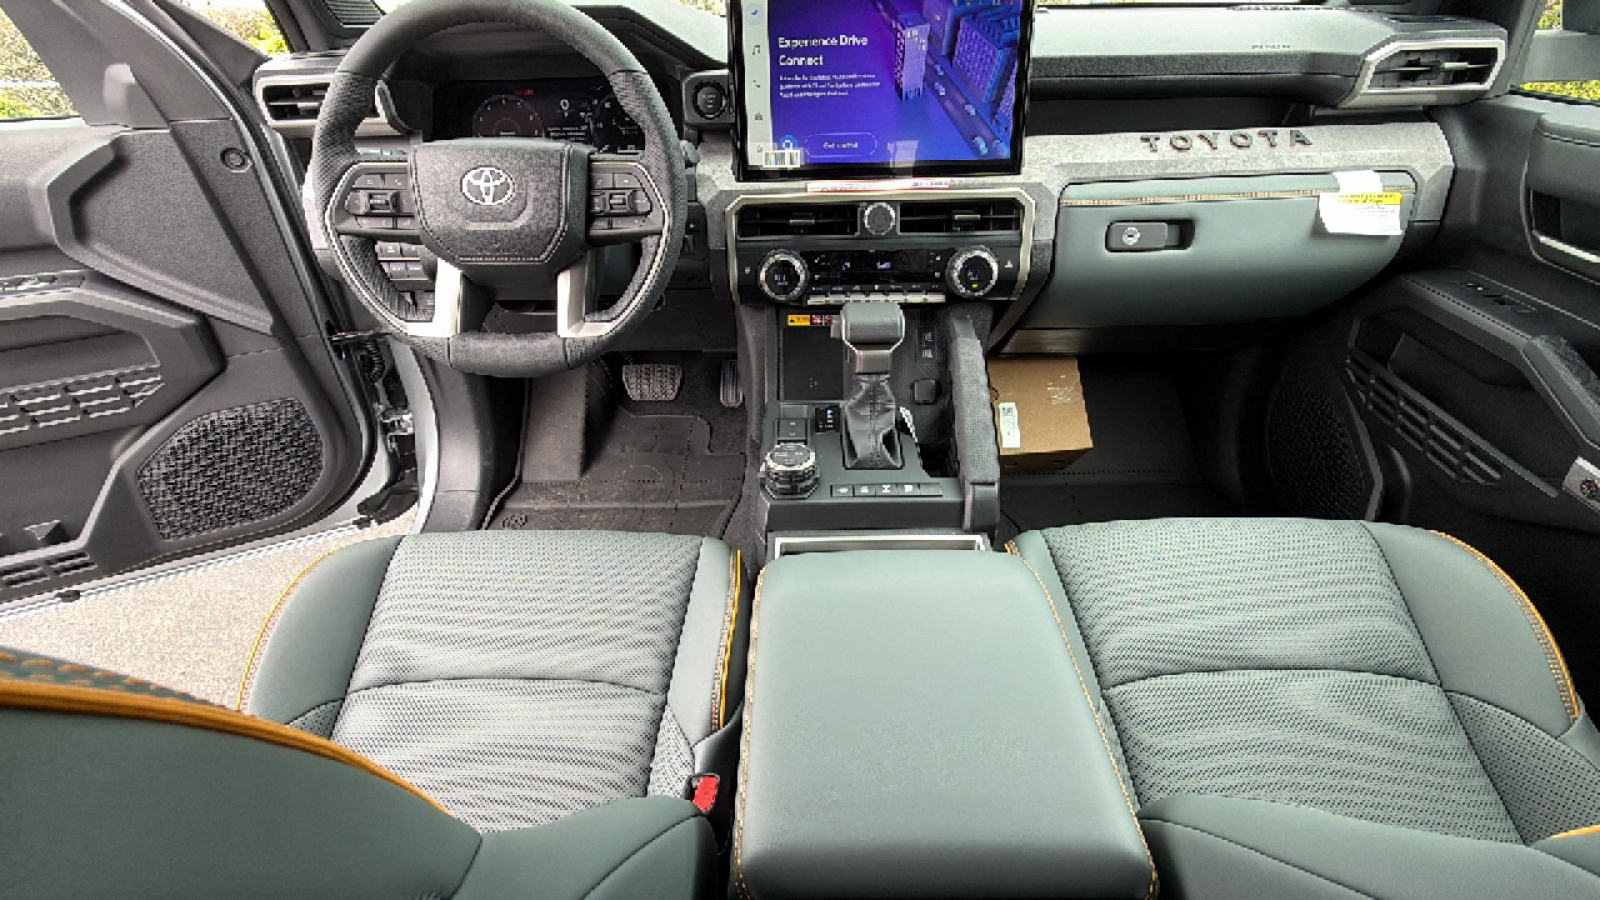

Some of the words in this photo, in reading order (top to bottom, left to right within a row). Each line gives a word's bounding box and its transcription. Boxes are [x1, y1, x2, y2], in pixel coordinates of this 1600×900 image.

[778, 37, 838, 50] Experience
[839, 35, 868, 46] Drive
[779, 55, 824, 66] Connect
[1140, 129, 1313, 153] TOYOTA
